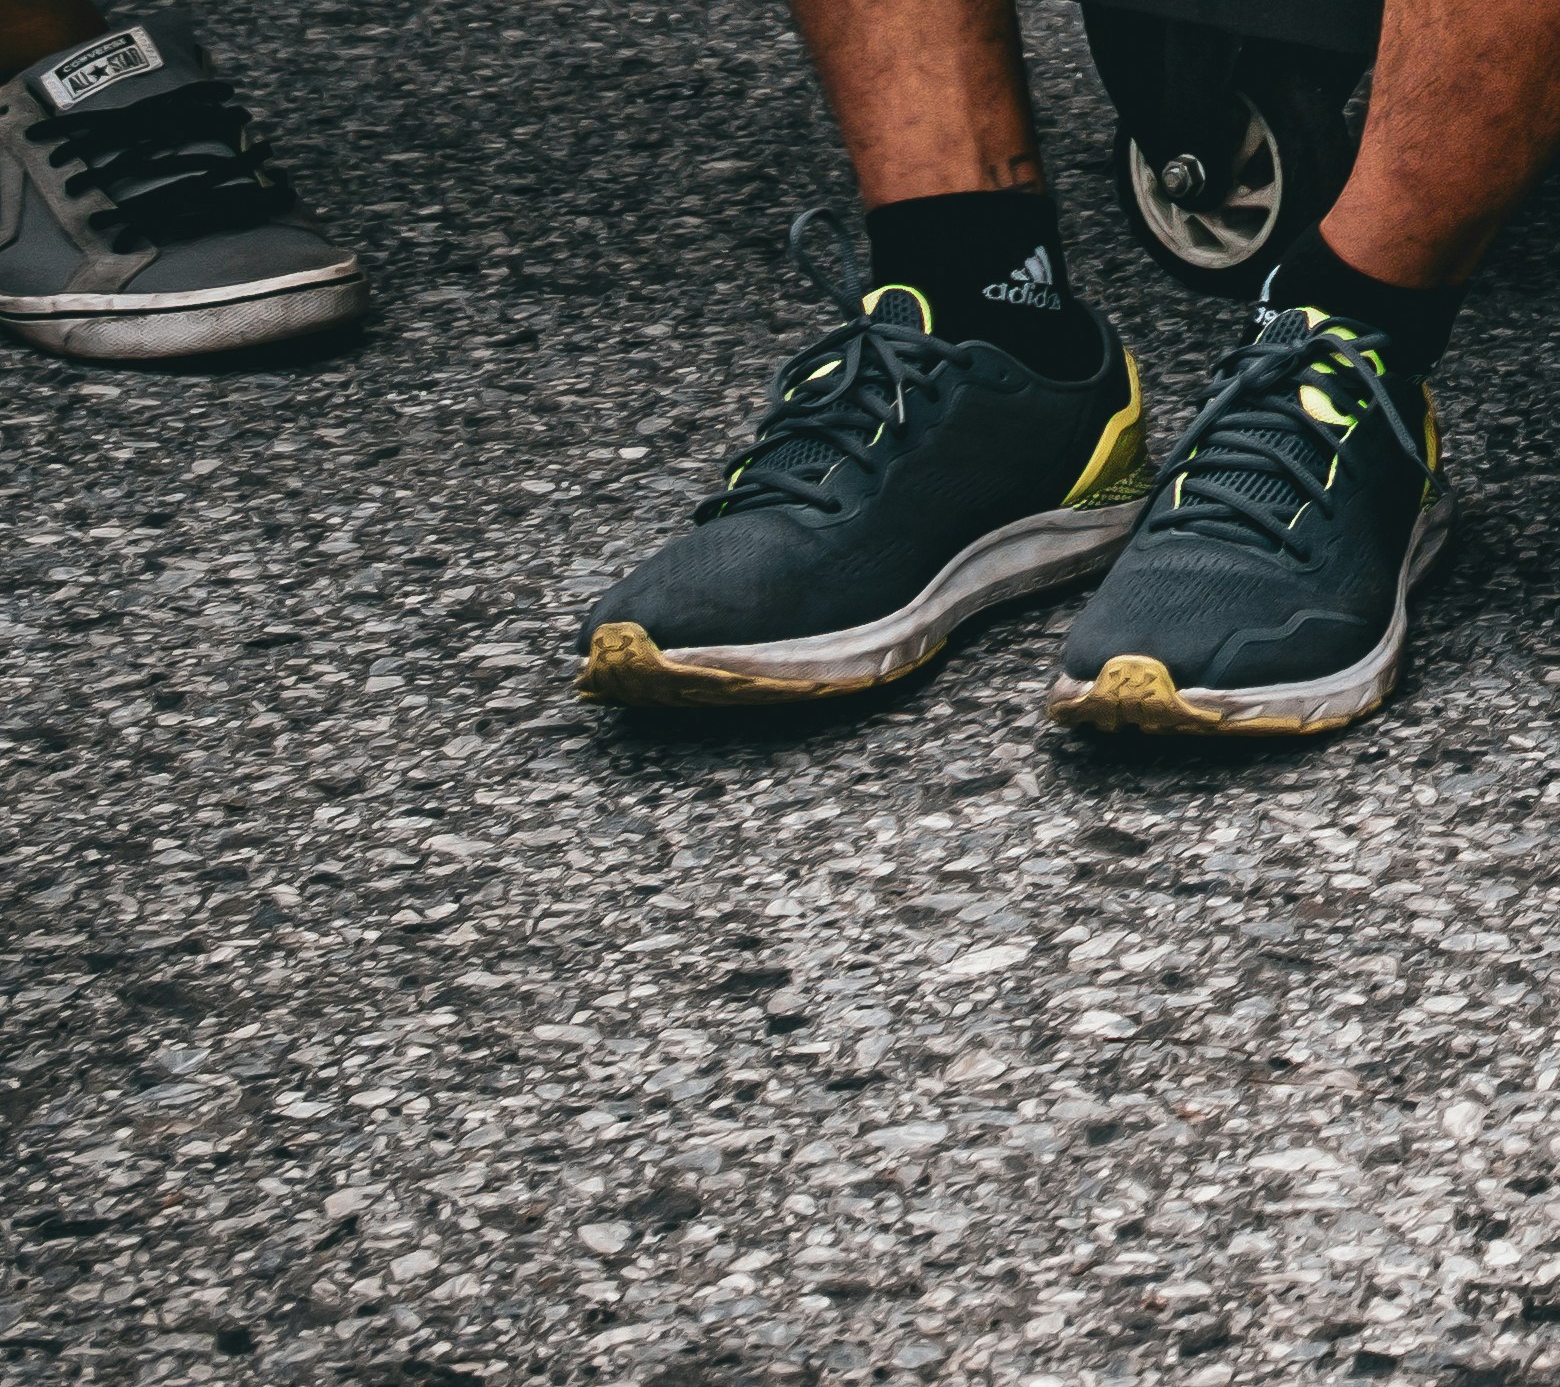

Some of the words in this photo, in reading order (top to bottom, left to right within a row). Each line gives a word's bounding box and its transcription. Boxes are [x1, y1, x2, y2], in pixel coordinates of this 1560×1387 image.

[62, 37, 127, 73] CONVERSE
[68, 70, 95, 95] ALL
[106, 47, 146, 73] STAR
